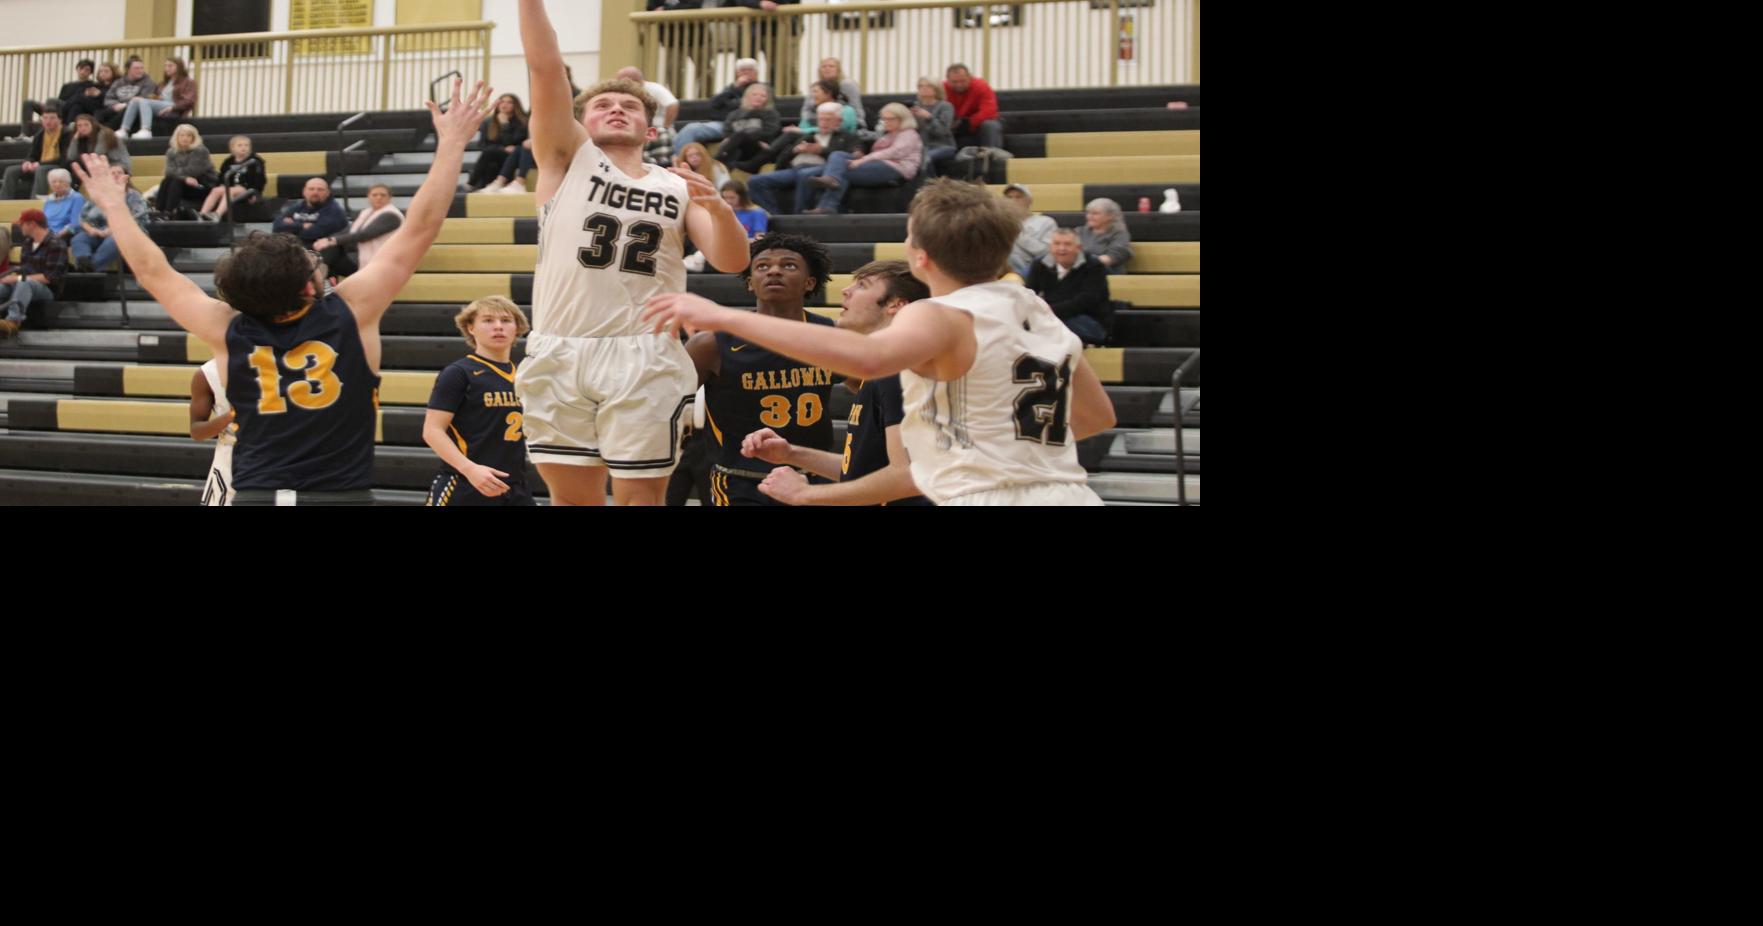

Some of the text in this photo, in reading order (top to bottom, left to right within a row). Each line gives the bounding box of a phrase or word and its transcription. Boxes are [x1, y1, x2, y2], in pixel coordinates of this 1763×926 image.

[587, 175, 680, 220] TIGERS
[577, 212, 664, 277] 32
[247, 340, 344, 415] 13
[760, 392, 823, 428] 30
[1011, 352, 1072, 447] 21
